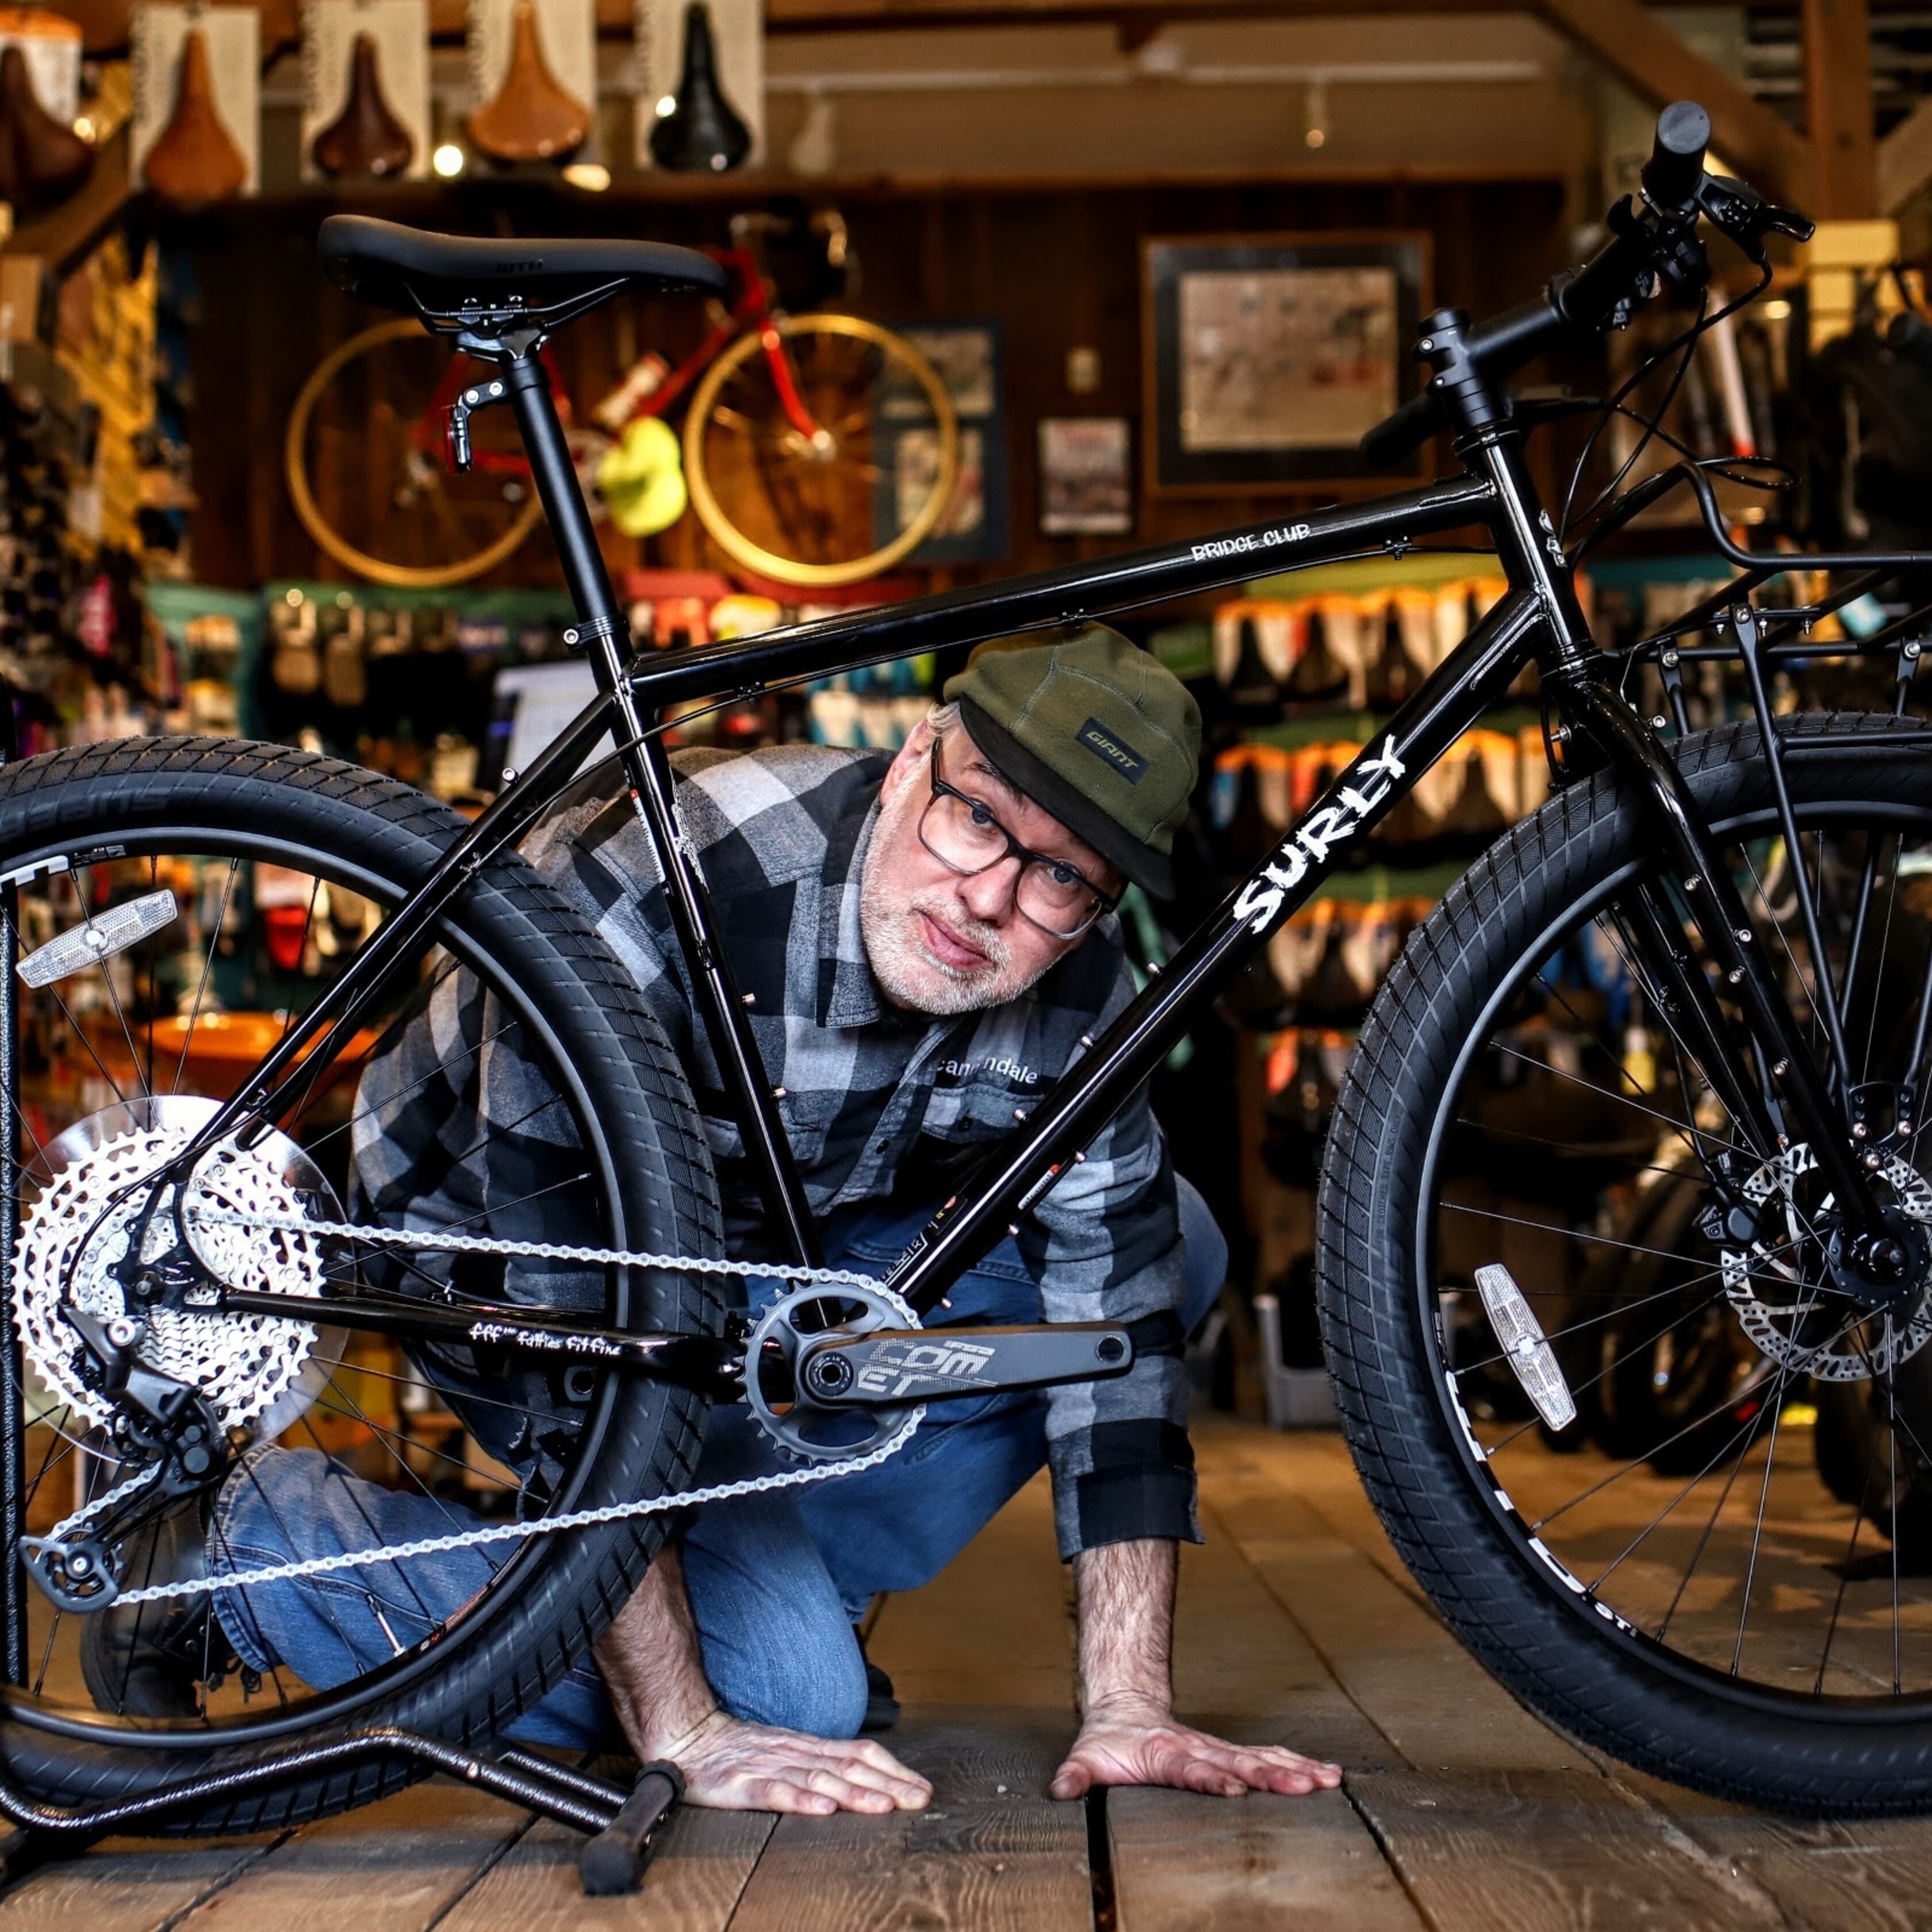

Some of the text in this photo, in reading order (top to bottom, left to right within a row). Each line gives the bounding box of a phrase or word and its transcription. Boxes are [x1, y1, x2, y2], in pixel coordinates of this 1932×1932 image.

[1191, 524, 1310, 561] BRIDGE CLUB
[1086, 731, 1139, 768] GIANT
[1232, 734, 1406, 935] SURLY
